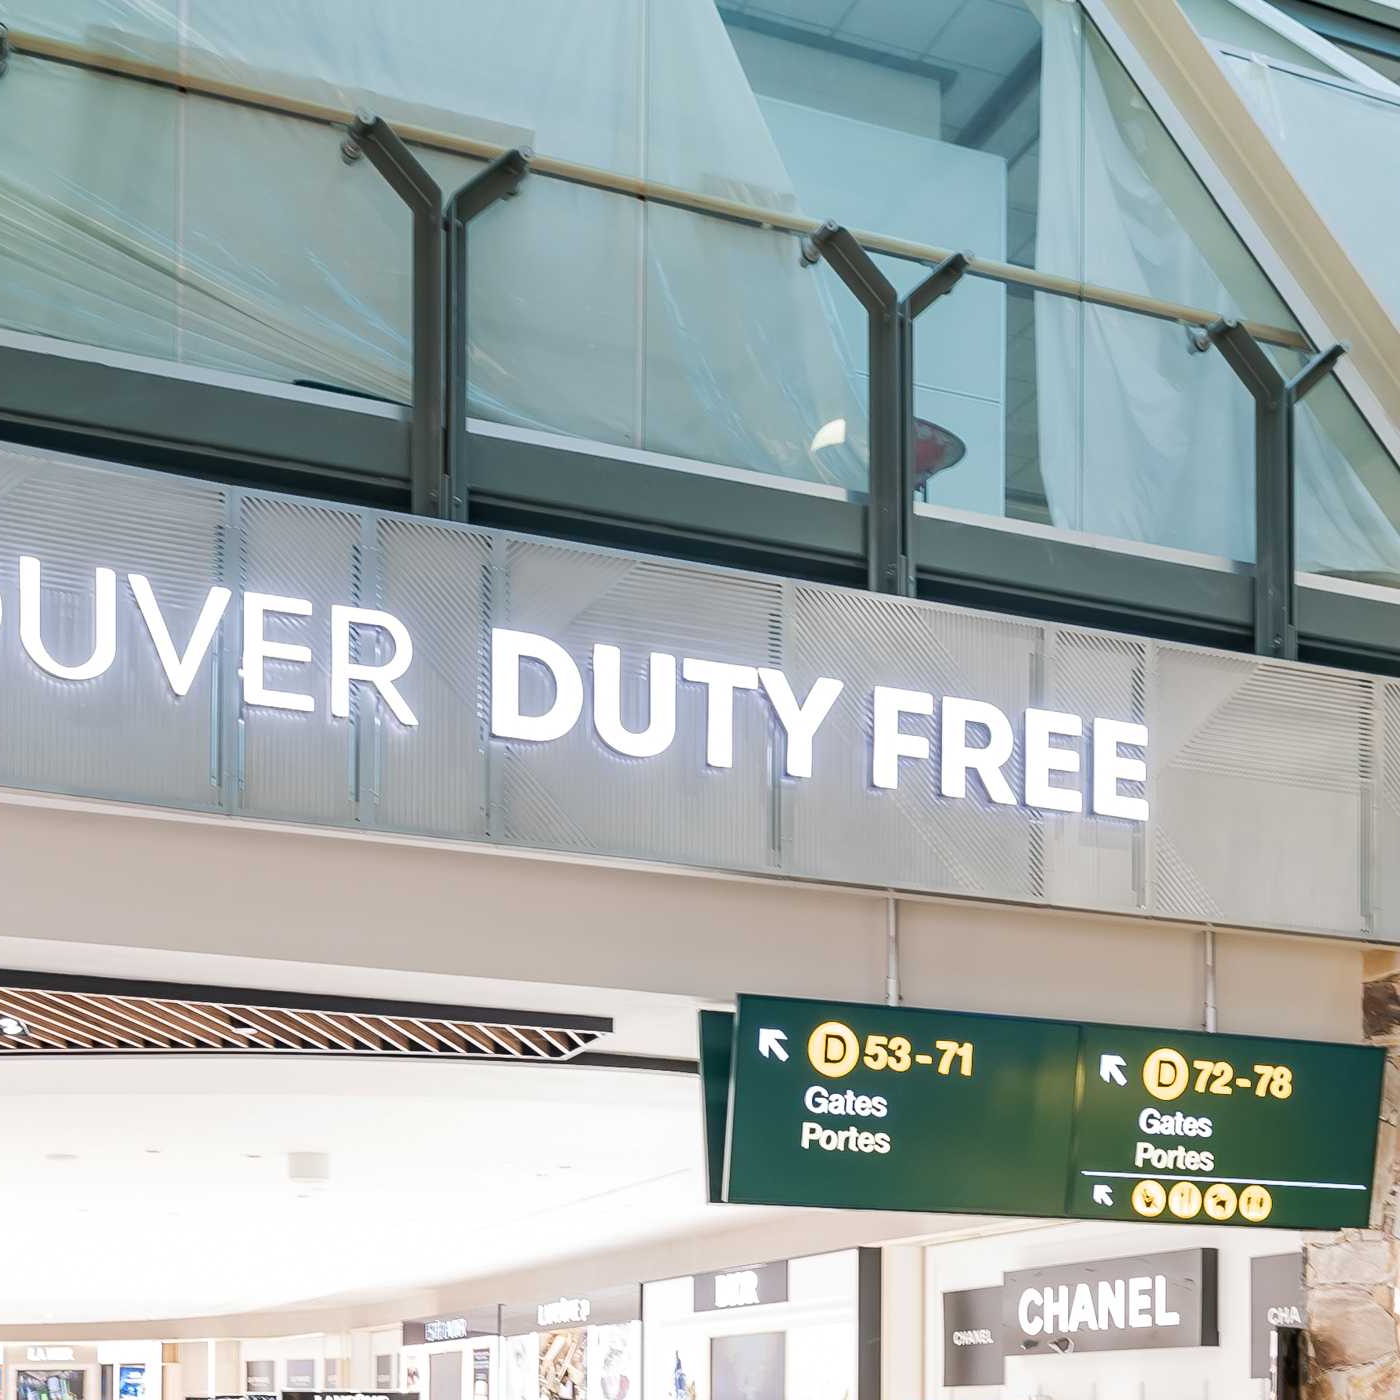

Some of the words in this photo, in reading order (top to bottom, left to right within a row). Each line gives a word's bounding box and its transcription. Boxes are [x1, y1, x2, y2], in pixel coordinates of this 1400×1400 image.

[491, 627, 844, 779] DUTY
[872, 685, 1151, 822] FREE
[862, 1034, 974, 1077] 53-71
[1192, 1059, 1294, 1100] 72-78
[803, 1085, 888, 1118] Gates
[800, 1121, 891, 1154] Portes
[1137, 1107, 1213, 1138] Gates
[1133, 1141, 1215, 1172] Portes
[1017, 1275, 1180, 1336] CHANEL
